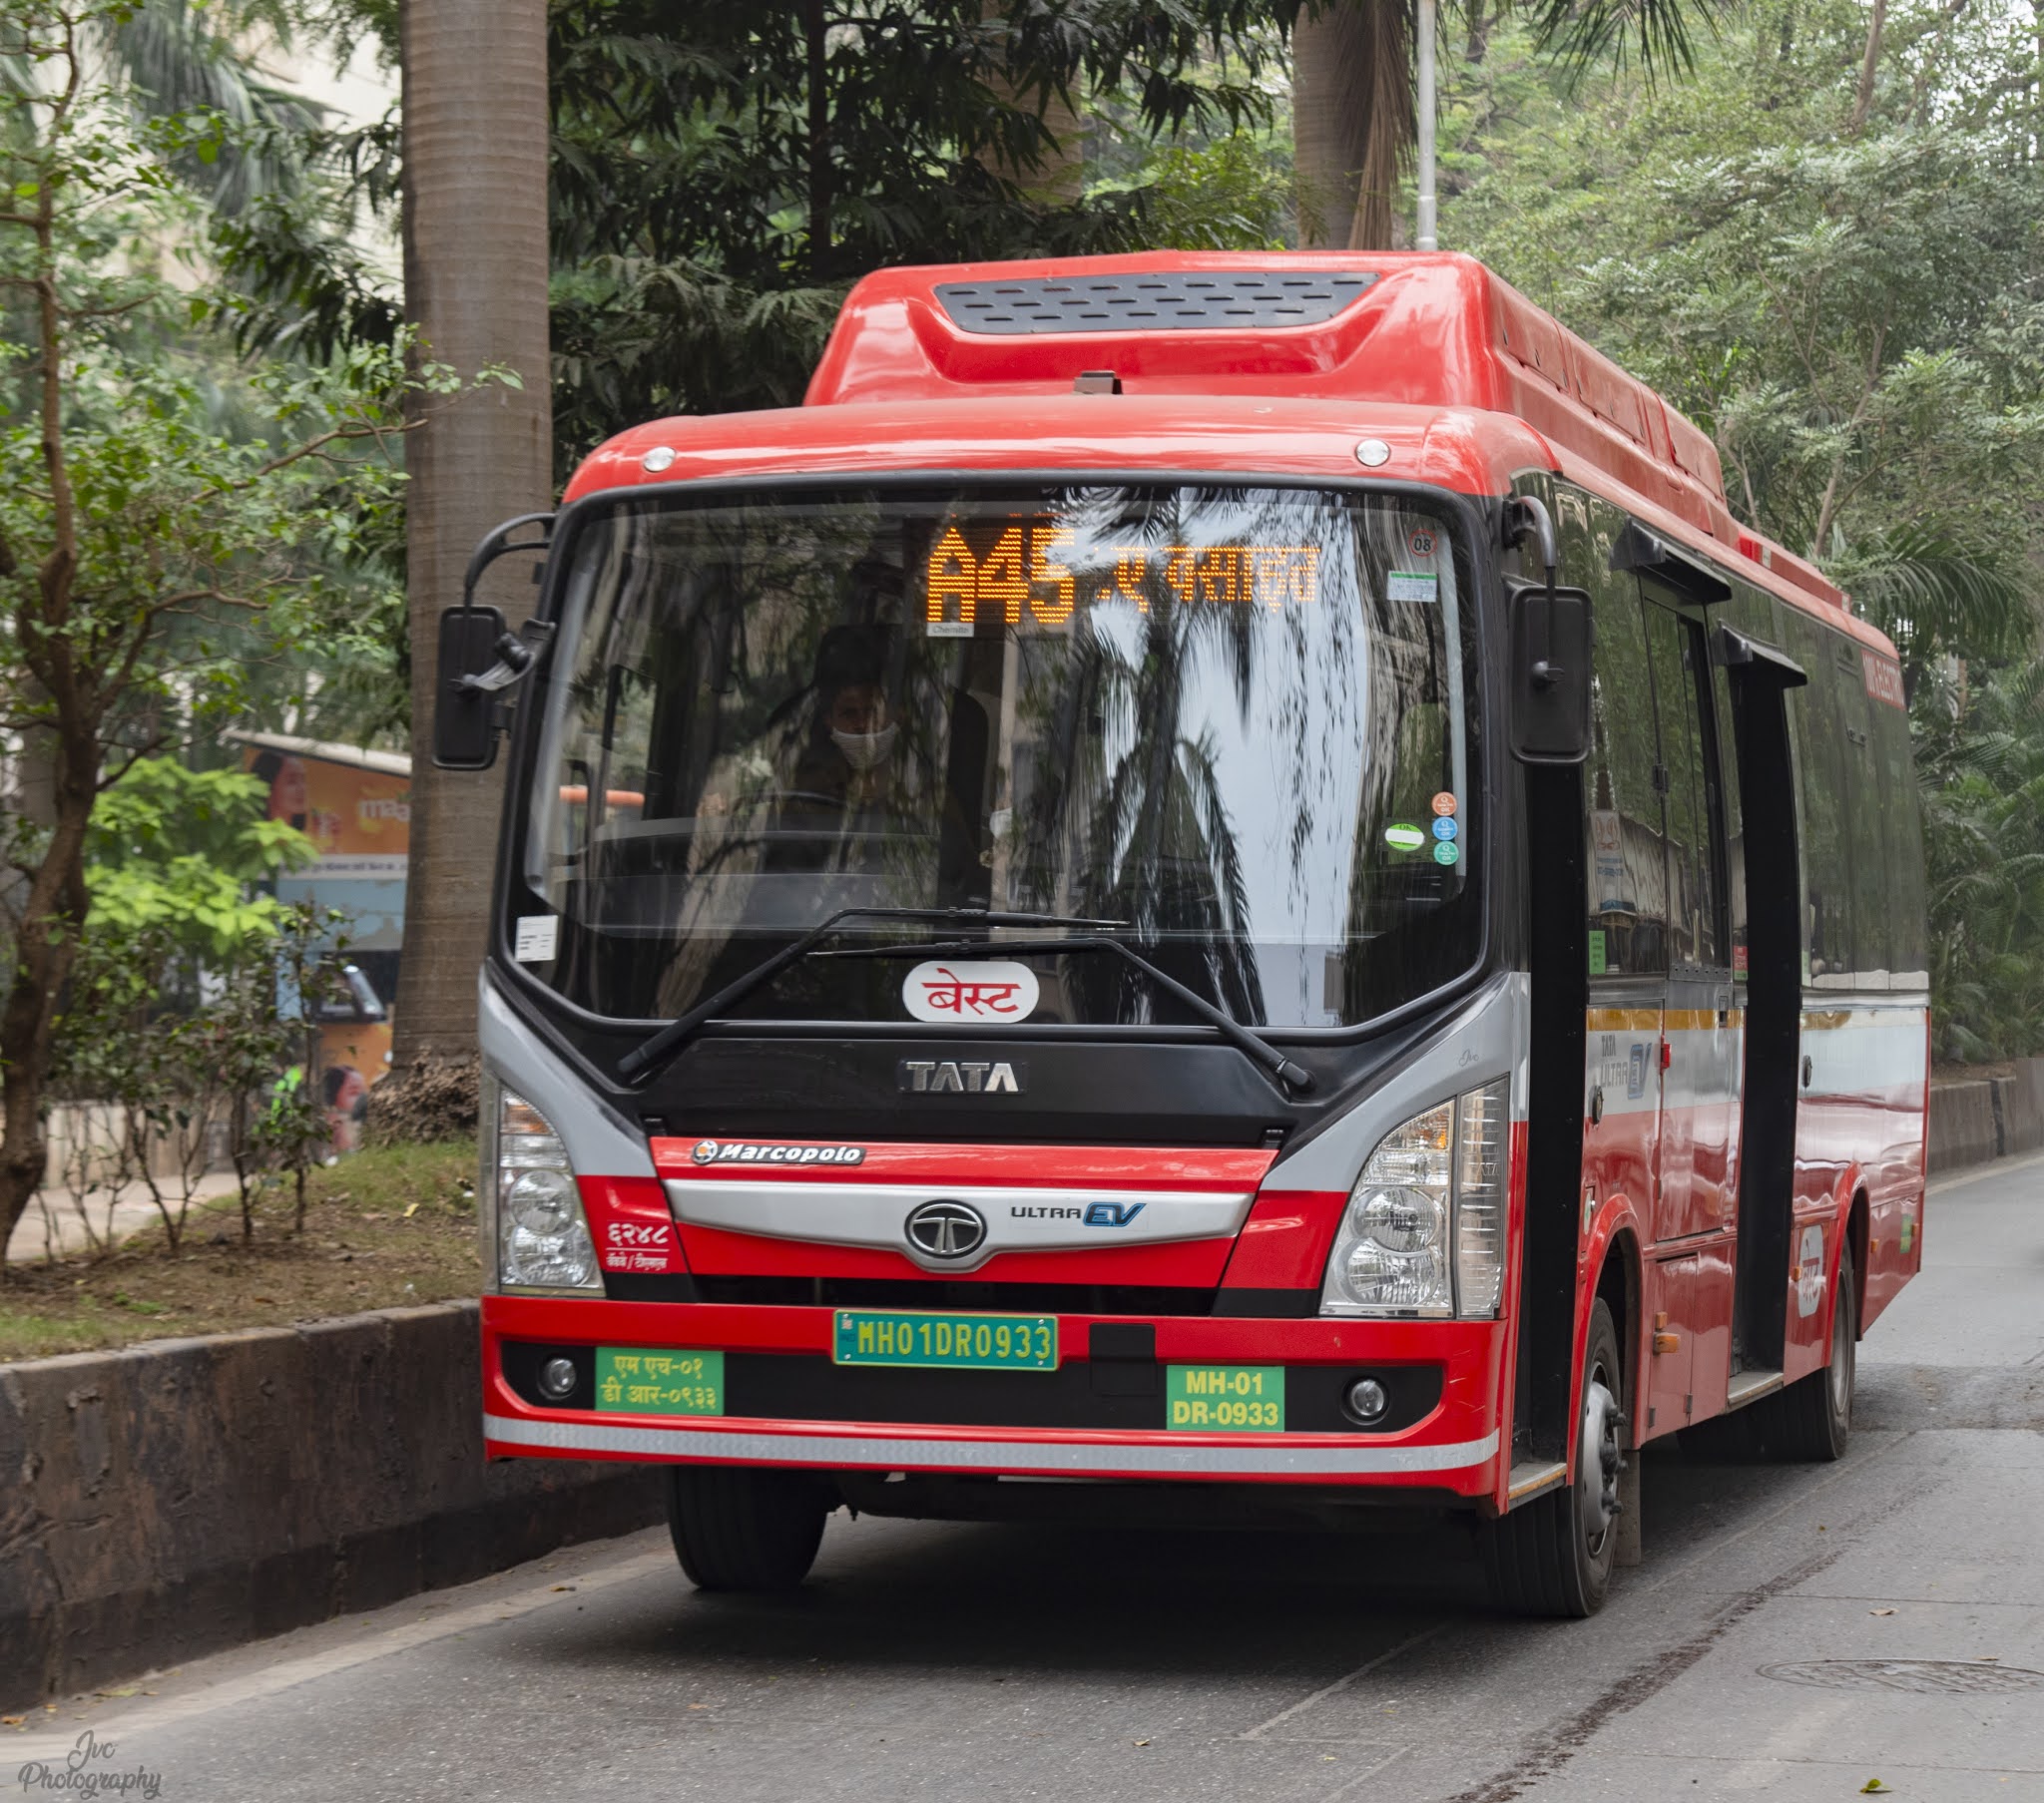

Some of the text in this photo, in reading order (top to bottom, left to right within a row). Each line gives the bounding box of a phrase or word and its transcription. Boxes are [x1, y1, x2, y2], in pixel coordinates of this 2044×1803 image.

[1414, 538, 1431, 552] 08
[927, 527, 1075, 623] A45
[921, 967, 1022, 1016] बेस्ट
[1601, 1034, 1617, 1058] TATA
[906, 1061, 1019, 1093] TATA
[1601, 1062, 1628, 1088] ULTRA
[719, 1143, 861, 1162] Marcopolo
[1011, 1201, 1148, 1227] ULTRA EV
[608, 1222, 670, 1247] ६२४८
[857, 1321, 1051, 1360] MH01DR0933
[614, 1355, 704, 1380] एम एच-०१
[600, 1375, 717, 1410] डी आर-०९३३
[1186, 1370, 1263, 1396] MH-01
[1173, 1400, 1278, 1426] DR-0933
